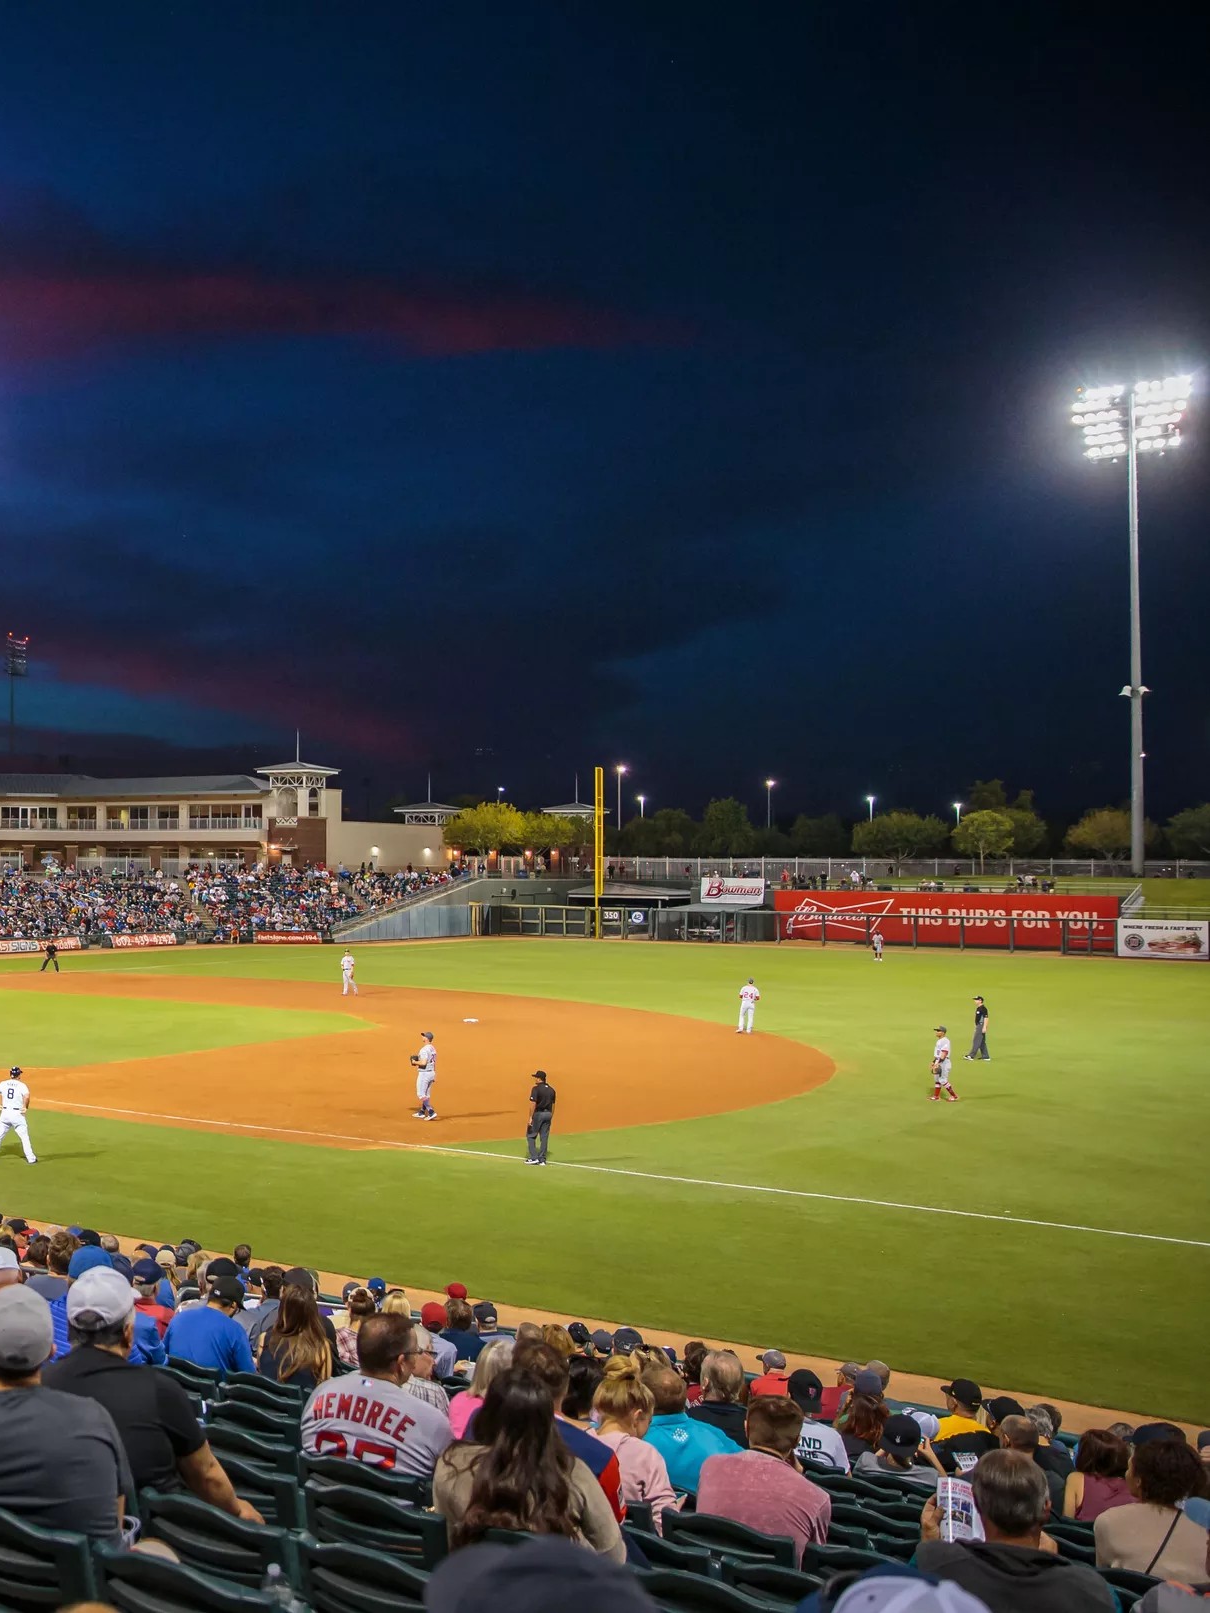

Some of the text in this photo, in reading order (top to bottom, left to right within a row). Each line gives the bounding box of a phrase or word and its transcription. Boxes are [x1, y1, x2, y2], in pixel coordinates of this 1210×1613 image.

[704, 878, 763, 898] Bowman
[604, 911, 619, 919] 350
[899, 907, 1104, 930] THIS BUD'S FOR YOU.
[743, 991, 754, 999] 24
[7, 1088, 14, 1099] 8
[313, 1392, 416, 1443] HEMBREE
[798, 1436, 822, 1450] ND
